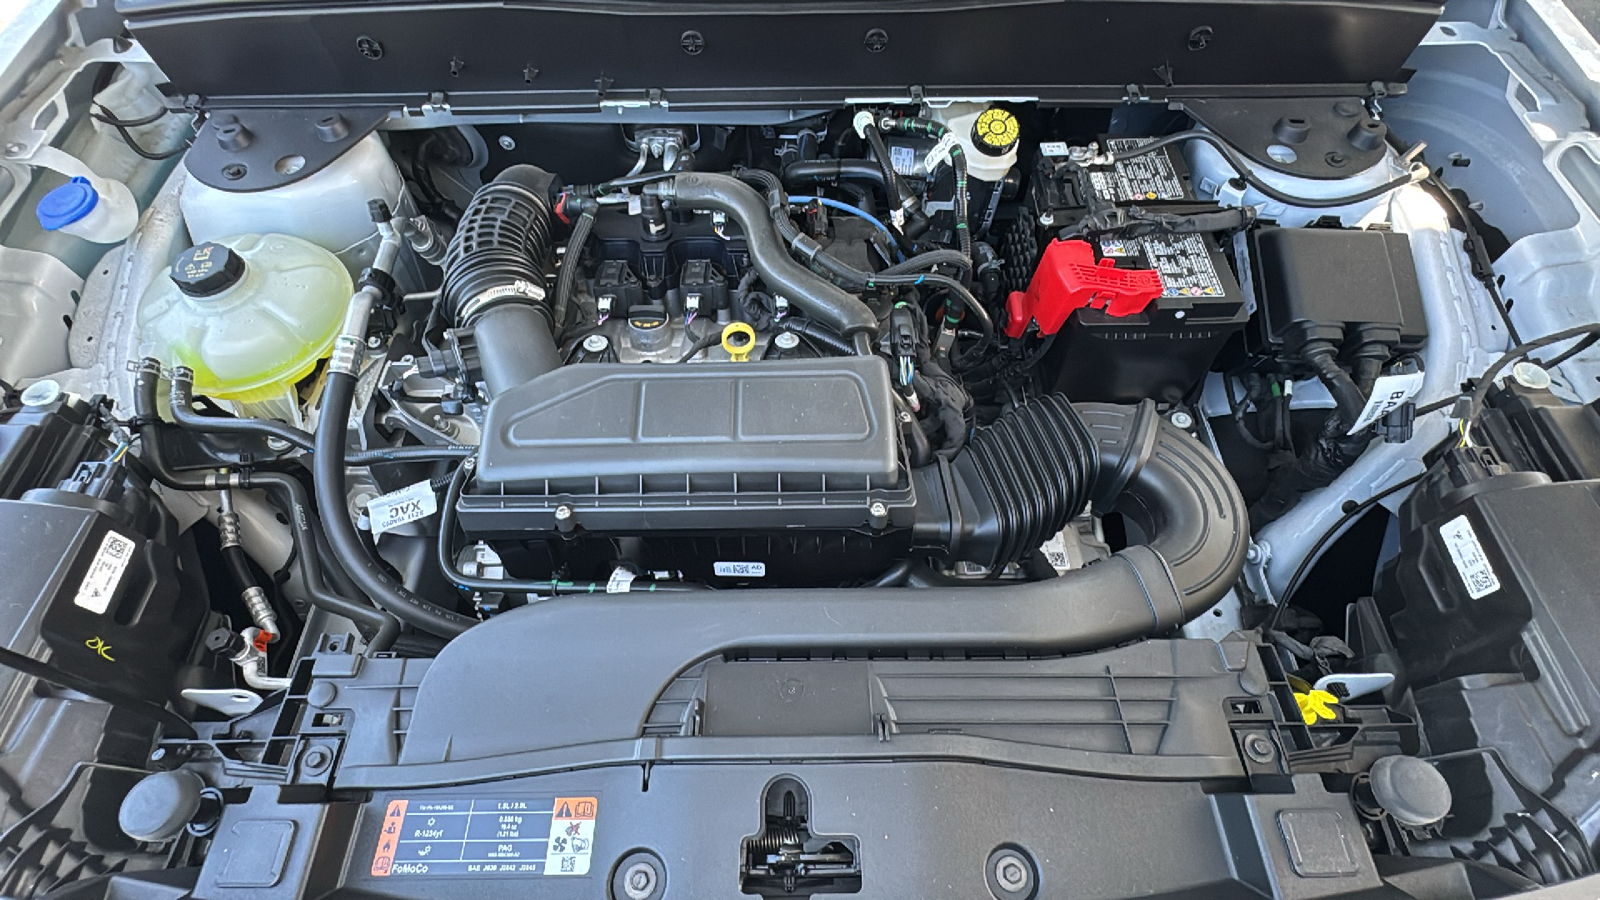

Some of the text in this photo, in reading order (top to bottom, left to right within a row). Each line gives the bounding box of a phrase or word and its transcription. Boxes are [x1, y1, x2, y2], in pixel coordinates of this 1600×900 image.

[389, 499, 422, 519] XAC
[414, 829, 444, 839] R-1234yf
[498, 844, 513, 853] PAG
[391, 863, 429, 874] FoMoCo
[468, 864, 481, 872] SAE
